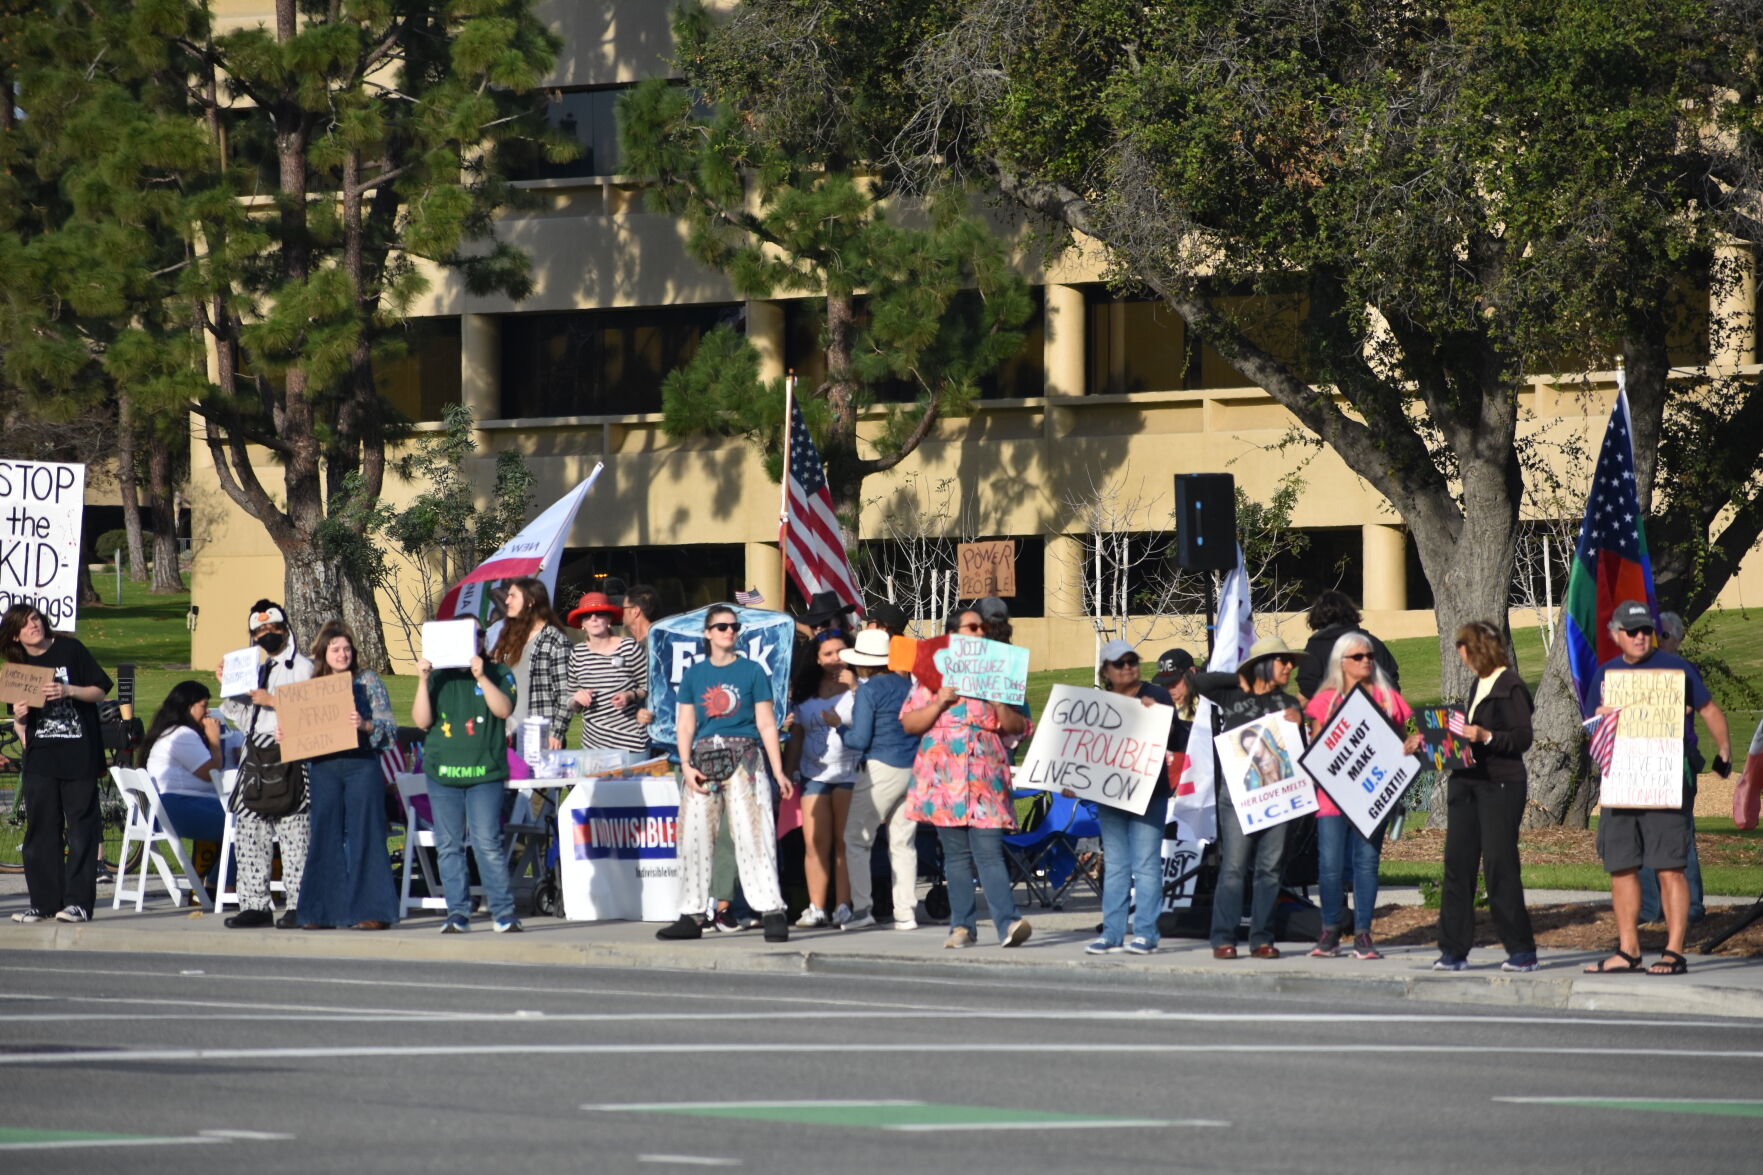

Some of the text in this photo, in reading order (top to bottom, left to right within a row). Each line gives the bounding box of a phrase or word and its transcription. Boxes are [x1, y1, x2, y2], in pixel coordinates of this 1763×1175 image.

[0, 463, 75, 503] STOP
[6, 507, 50, 538] the
[0, 540, 69, 588] KID-
[963, 543, 1012, 572] POWER
[670, 635, 775, 683] Fk
[953, 638, 989, 657] JOIN
[944, 656, 1006, 675] RODRIGUEZ
[24, 684, 38, 694] ICE
[279, 683, 312, 706] MAKE
[1609, 673, 1677, 690] WE BELIEVE
[1607, 690, 1682, 705] IN MONEY FOR
[298, 704, 340, 728] AFRAID
[1052, 699, 1122, 730] GOOD
[1424, 709, 1449, 729] SAVE
[1623, 707, 1676, 722] OOD AND
[297, 734, 334, 752] AGAIN
[1324, 717, 1351, 751] HATE
[1618, 722, 1680, 738] MEDICINE
[1061, 728, 1162, 776] TROUBLE
[1327, 719, 1371, 777] WILL NOT
[438, 764, 488, 778] PIKMIN
[1346, 744, 1376, 782] MAKE
[1658, 756, 1673, 772] IN
[1029, 760, 1140, 801] LIVES ON
[1241, 779, 1308, 809] HER LOVE MELTS
[1361, 766, 1387, 794] U.S.
[1368, 768, 1408, 820] GREAT!!!
[1246, 795, 1313, 826] I.C.E.
[589, 816, 675, 848] INDIVISIBLE
